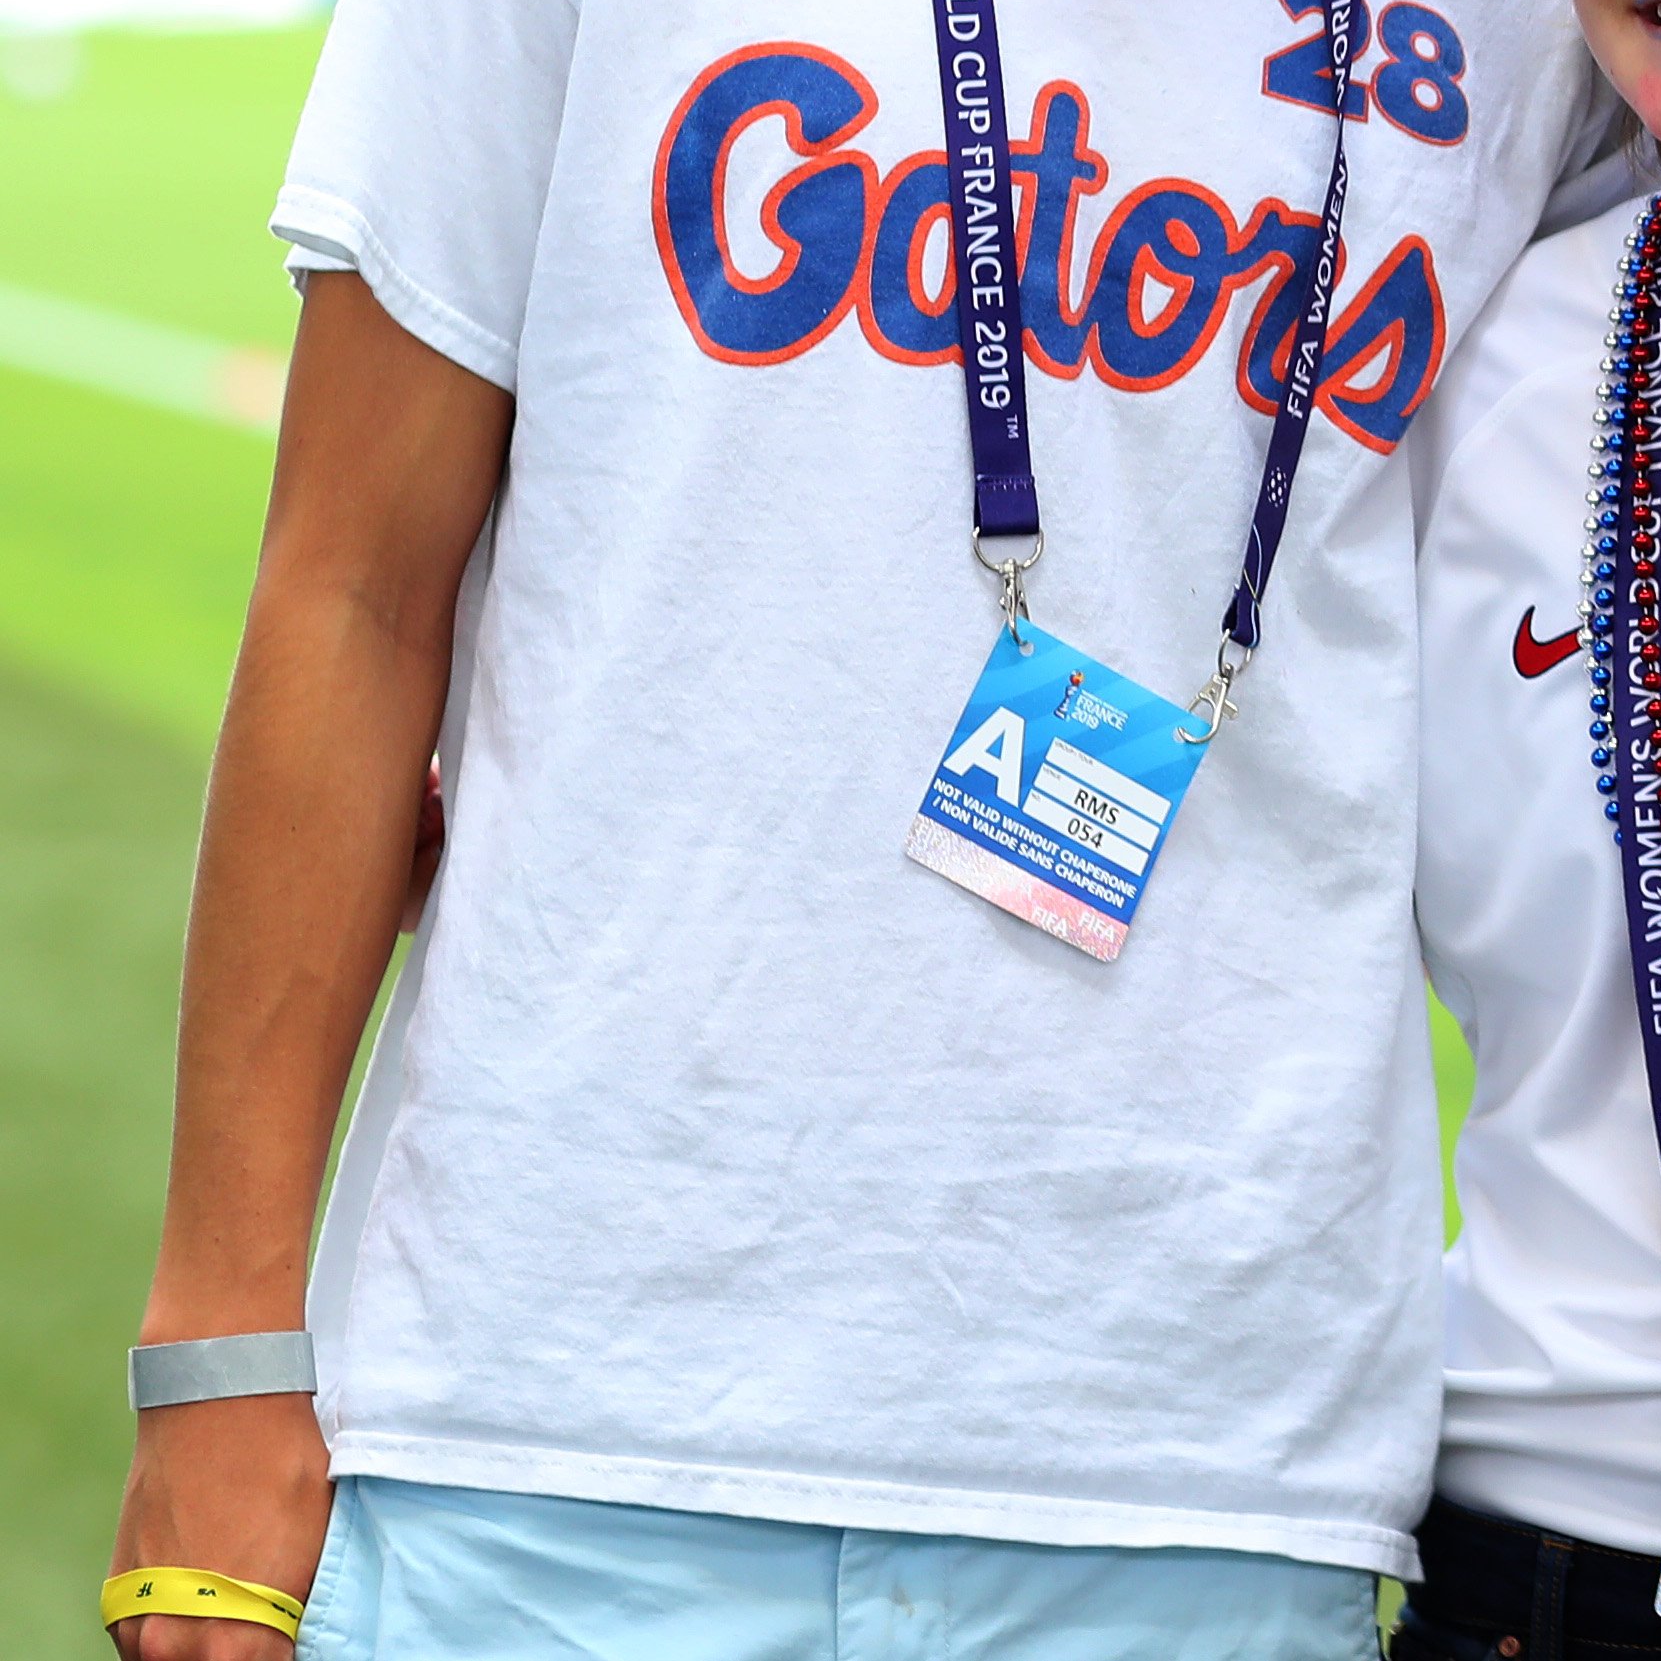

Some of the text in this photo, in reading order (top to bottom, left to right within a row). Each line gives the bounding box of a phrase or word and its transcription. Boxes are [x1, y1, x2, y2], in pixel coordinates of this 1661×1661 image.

[950, 49, 993, 136] CUP
[650, 38, 1447, 457] Gators
[960, 141, 1004, 311] FRANCE
[1285, 338, 1319, 422] FIFA
[1307, 150, 1349, 325] WOMEN'
[974, 318, 1013, 411] 2019
[943, 705, 1026, 808] A
[1070, 708, 1101, 732] 2019
[1074, 694, 1131, 733] FRANCE
[933, 778, 1139, 900] NOT VALID WITHOUT CHAPERONE
[940, 799, 973, 826] NON
[972, 814, 1019, 851] VALIDE
[1017, 838, 1055, 872] SANS
[1053, 857, 1126, 910] CHAPERON
[1066, 817, 1104, 850] 054
[1073, 787, 1121, 827] RMS
